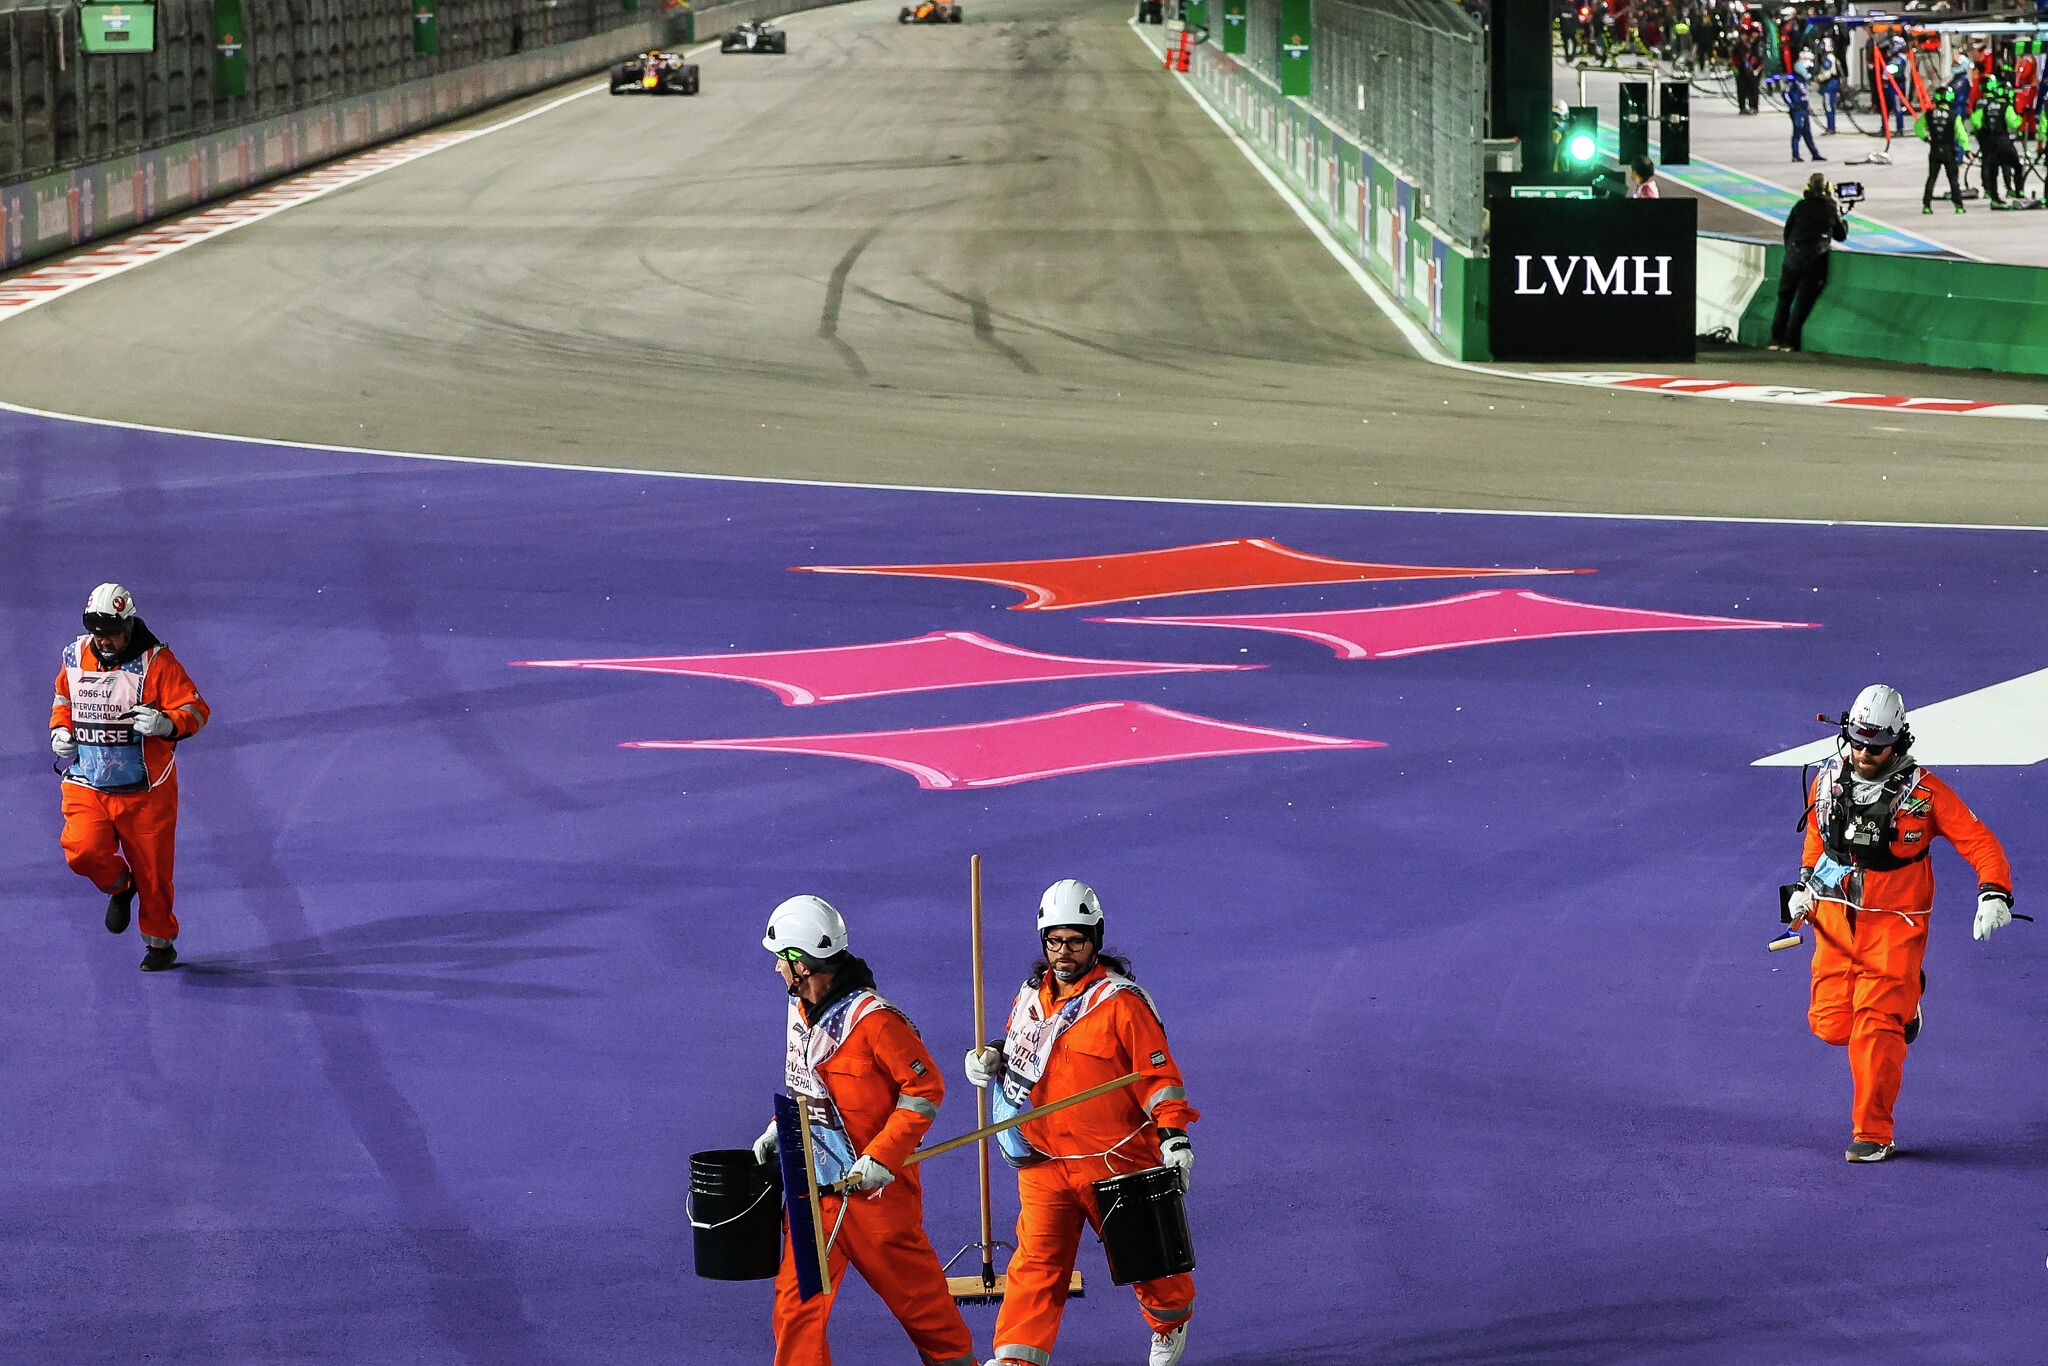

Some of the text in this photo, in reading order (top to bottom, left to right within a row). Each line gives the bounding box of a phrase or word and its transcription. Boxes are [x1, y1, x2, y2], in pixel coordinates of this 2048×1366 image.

[1514, 255, 1672, 295] LVMH
[78, 689, 112, 699] 0966-LV
[78, 711, 112, 721] MARSHAL
[75, 727, 128, 743] OURSE
